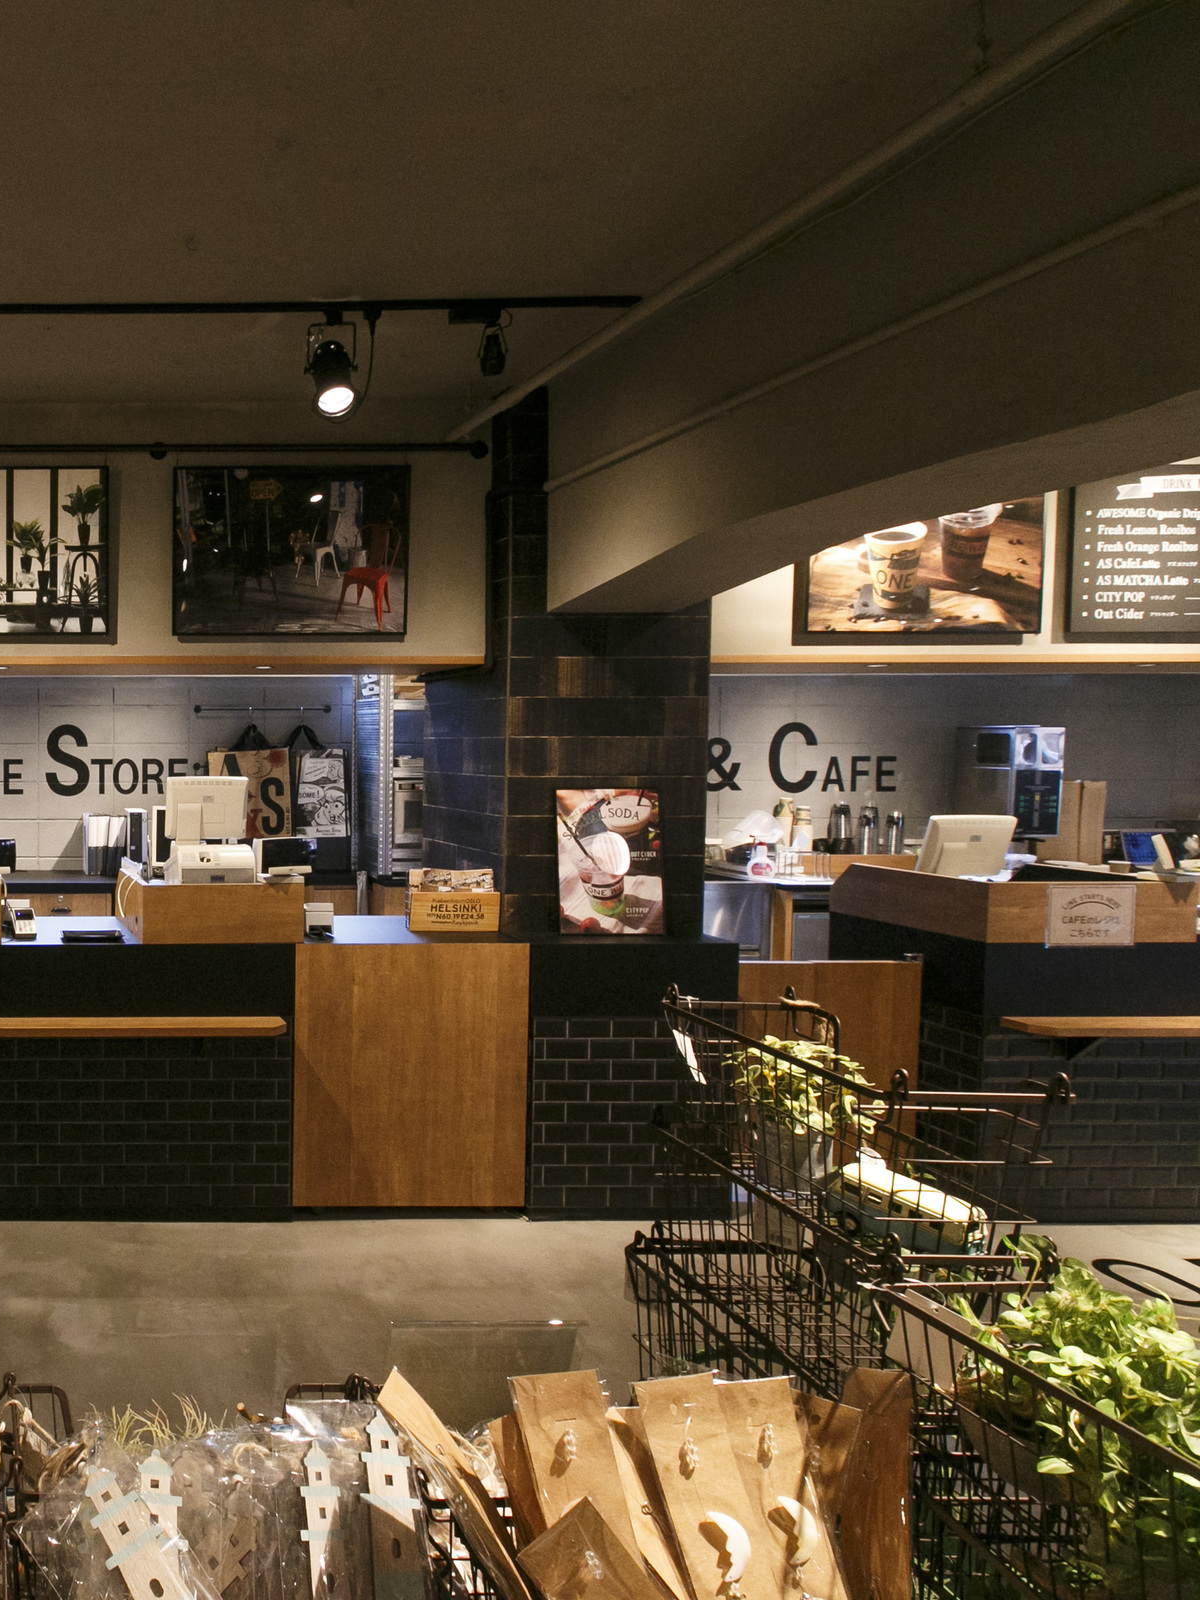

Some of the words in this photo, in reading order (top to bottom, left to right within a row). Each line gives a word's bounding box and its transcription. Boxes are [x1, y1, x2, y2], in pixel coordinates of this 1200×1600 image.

[1163, 478, 1192, 489] DRINK
[1096, 507, 1146, 518] AWESOME
[1146, 507, 1181, 520] Organic
[1097, 524, 1124, 535] Fresh
[1125, 524, 1158, 535] Lemon
[1159, 524, 1196, 535] Rooibos
[1097, 541, 1124, 552] Fresh
[1125, 541, 1160, 554] Orange
[1161, 541, 1198, 552] Rooibos
[1096, 558, 1113, 569] AS
[1113, 558, 1161, 569] CafeLatte
[876, 569, 915, 589] ONE
[1095, 574, 1112, 586] AS
[1113, 574, 1163, 586] MATCHA
[1163, 574, 1189, 586] Latte
[1095, 591, 1123, 602] CITY
[1123, 591, 1146, 602] POP
[1094, 608, 1114, 619] Out
[1115, 608, 1145, 619] Cider
[706, 737, 742, 792] &
[768, 722, 897, 793] CAFE
[260, 777, 285, 835] S
[608, 808, 640, 821] SODA
[587, 886, 608, 896] ONE
[1061, 897, 1078, 910] LINE
[1079, 893, 1105, 901] STARTS
[430, 904, 482, 912] HELSINKI
